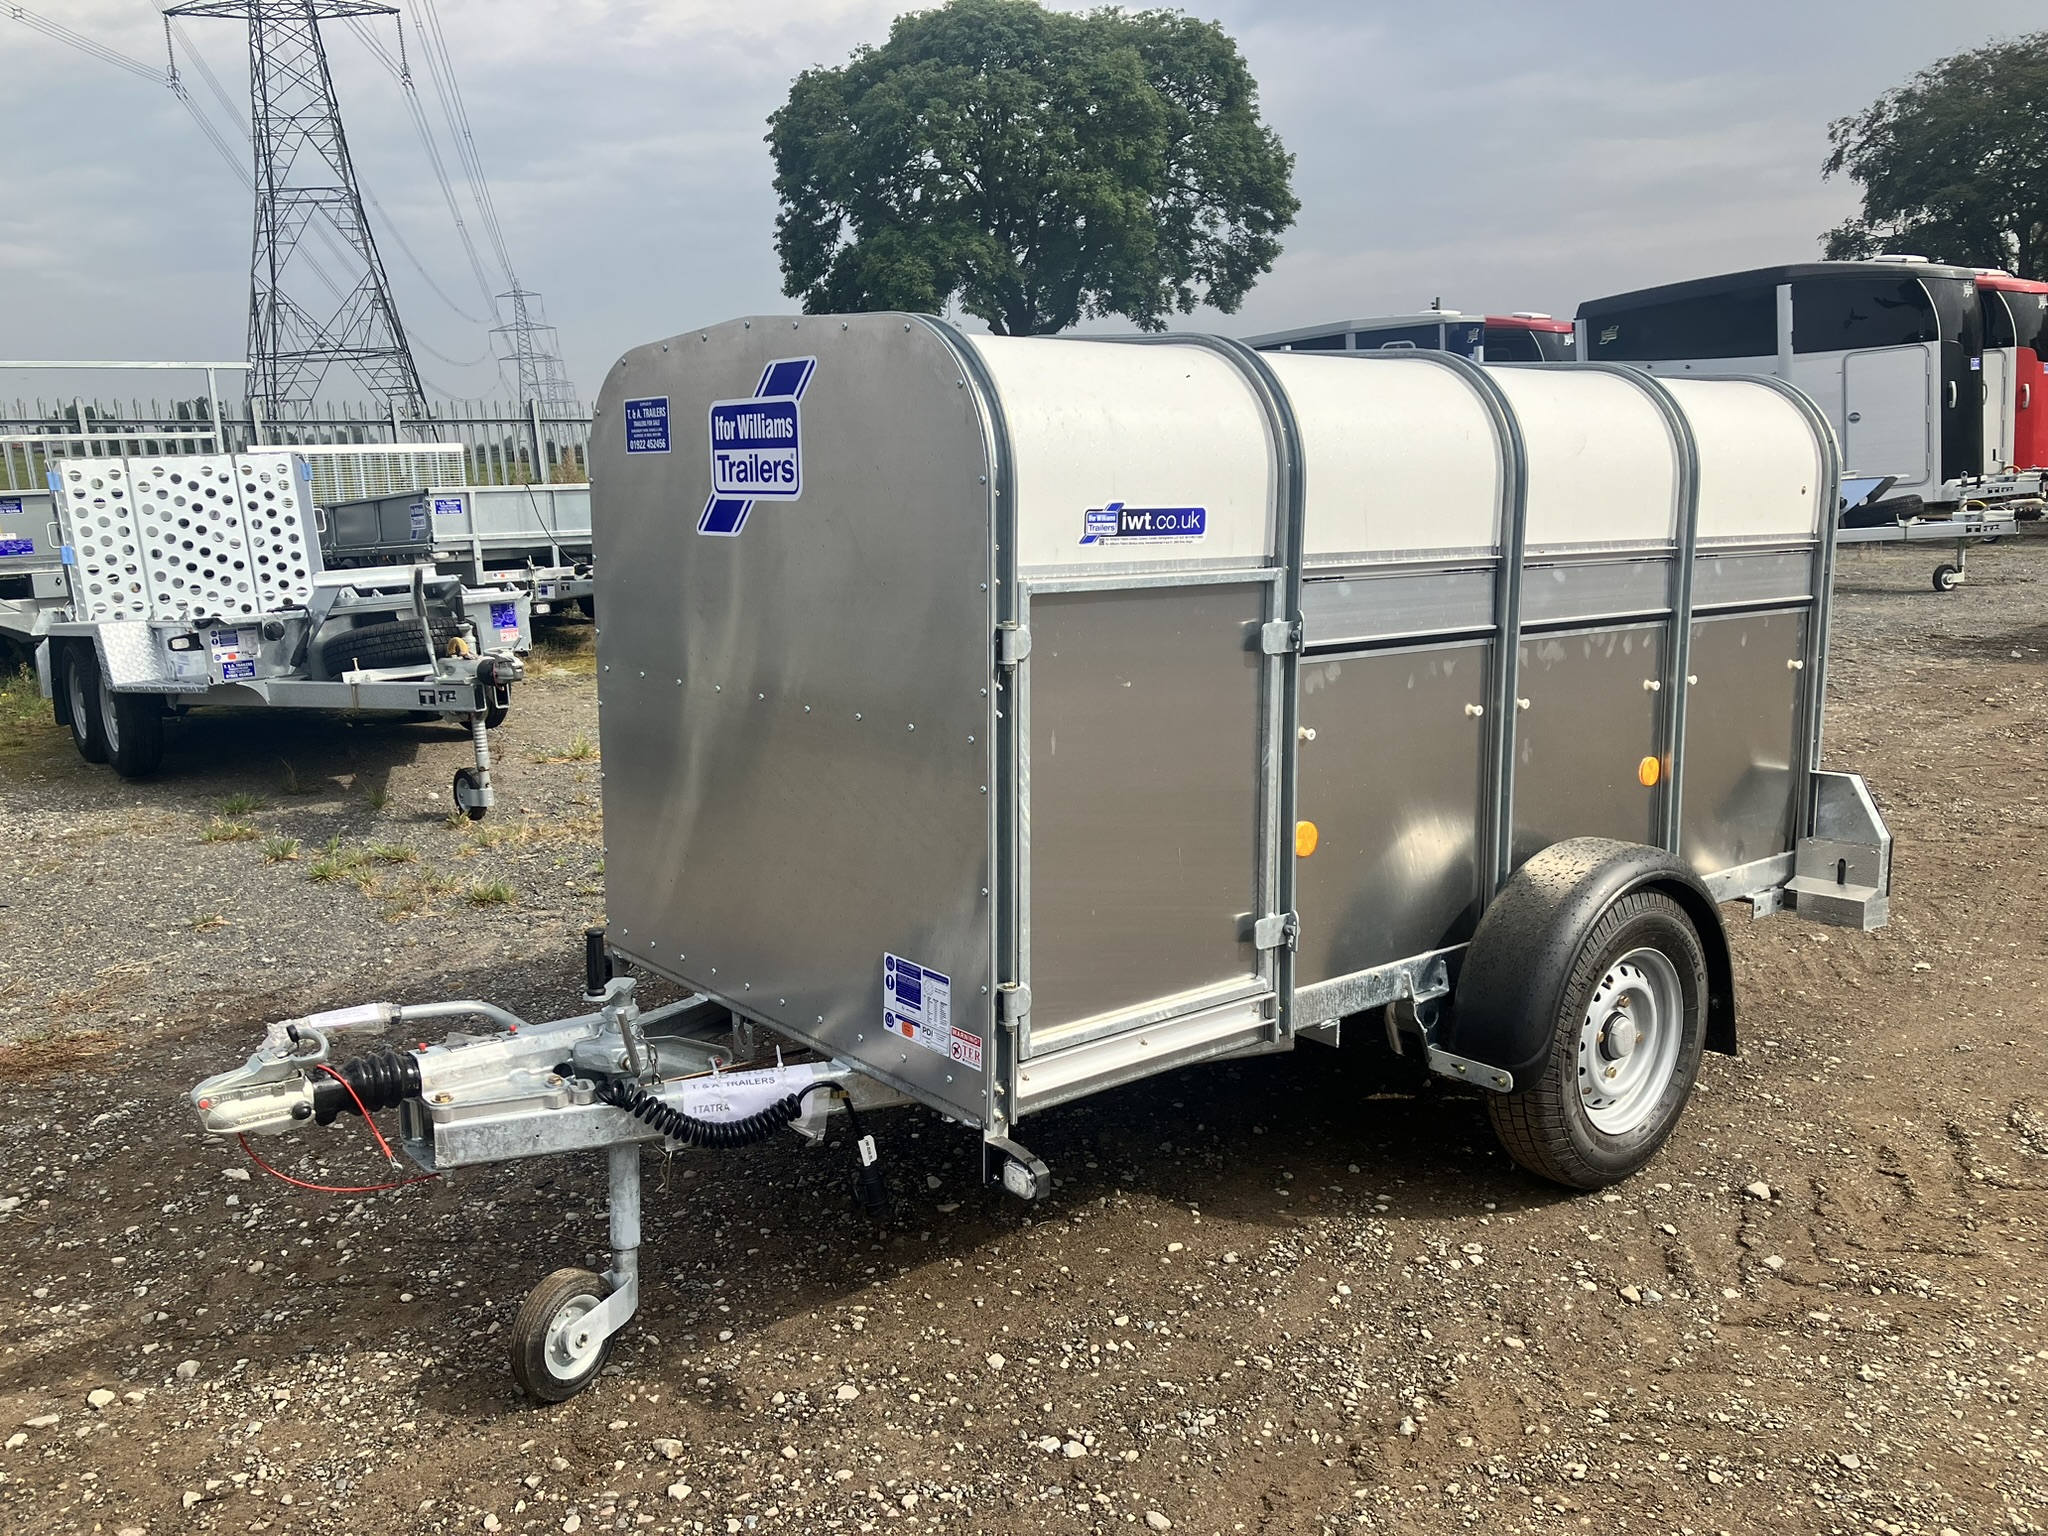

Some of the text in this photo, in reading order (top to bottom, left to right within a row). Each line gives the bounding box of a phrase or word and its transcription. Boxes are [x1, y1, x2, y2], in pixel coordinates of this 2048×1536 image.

[643, 406, 666, 418] TRAILERS
[714, 413, 794, 441] Ifor Williams
[717, 454, 795, 483] Trailers
[1121, 511, 1201, 530] iwt.co.uk
[1088, 523, 1115, 532] Trailers
[922, 1026, 934, 1037] PDI
[726, 1076, 776, 1088] TRAILERS
